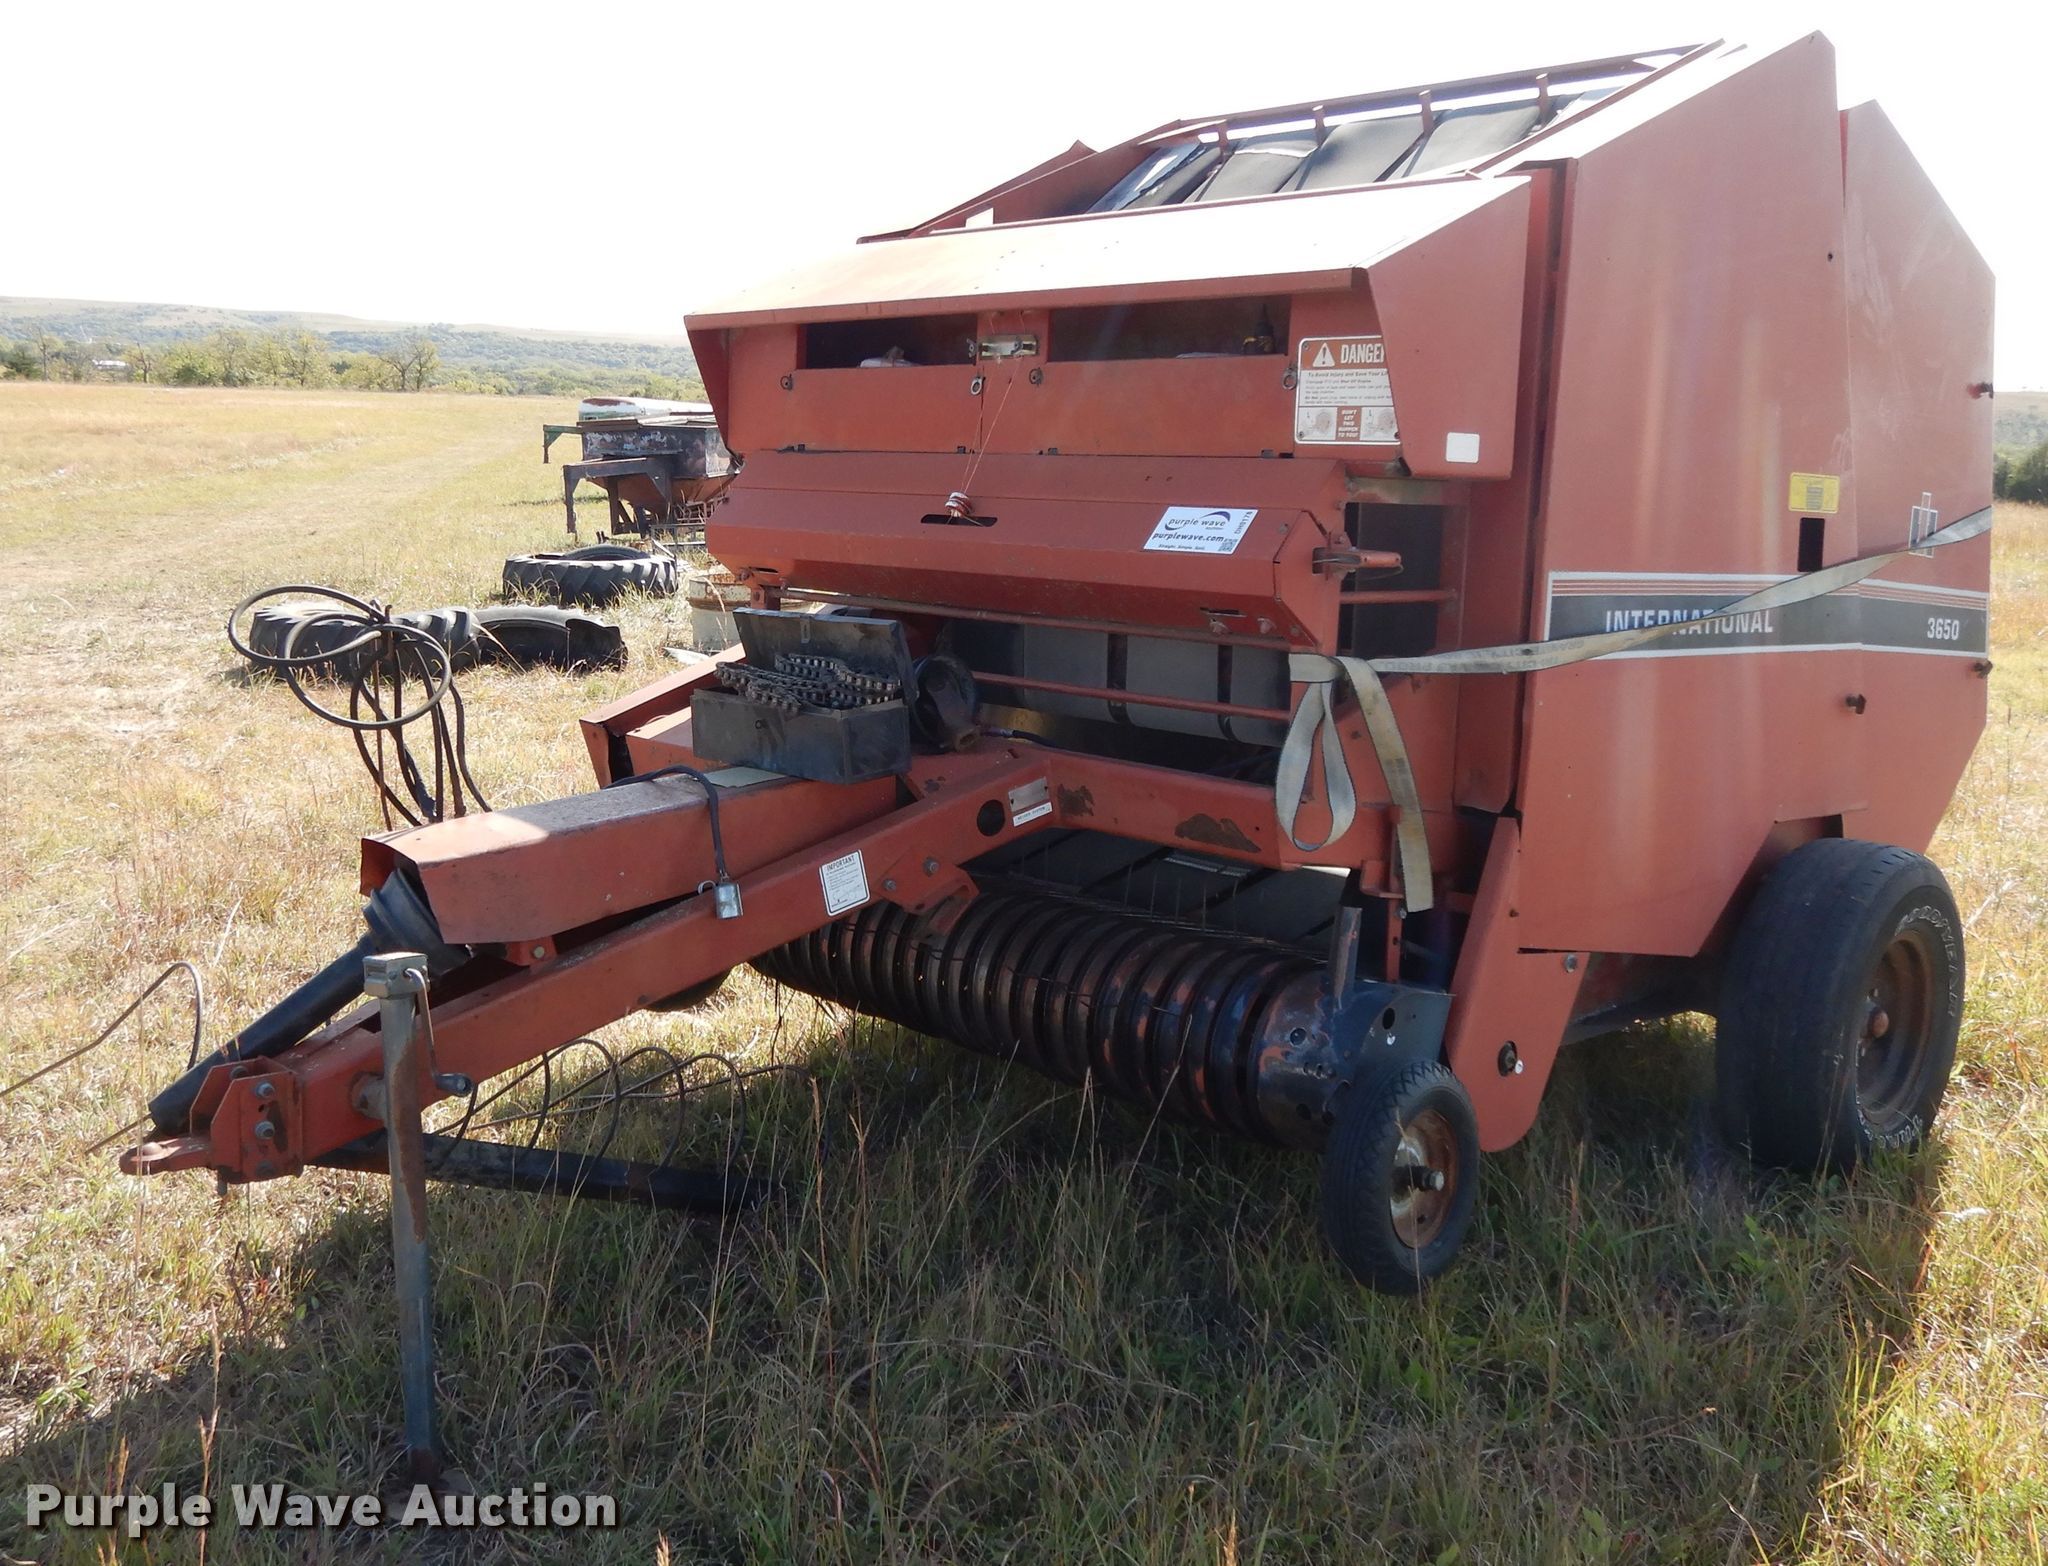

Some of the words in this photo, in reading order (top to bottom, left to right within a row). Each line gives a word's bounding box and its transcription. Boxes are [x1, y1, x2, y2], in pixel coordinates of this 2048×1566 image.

[1168, 518, 1199, 526] purple
[1152, 532, 1225, 542] purplewave.com
[1606, 609, 1773, 635] INTERNATIONAL
[1927, 617, 1960, 640] 3650
[826, 855, 855, 870] IMPORTANT
